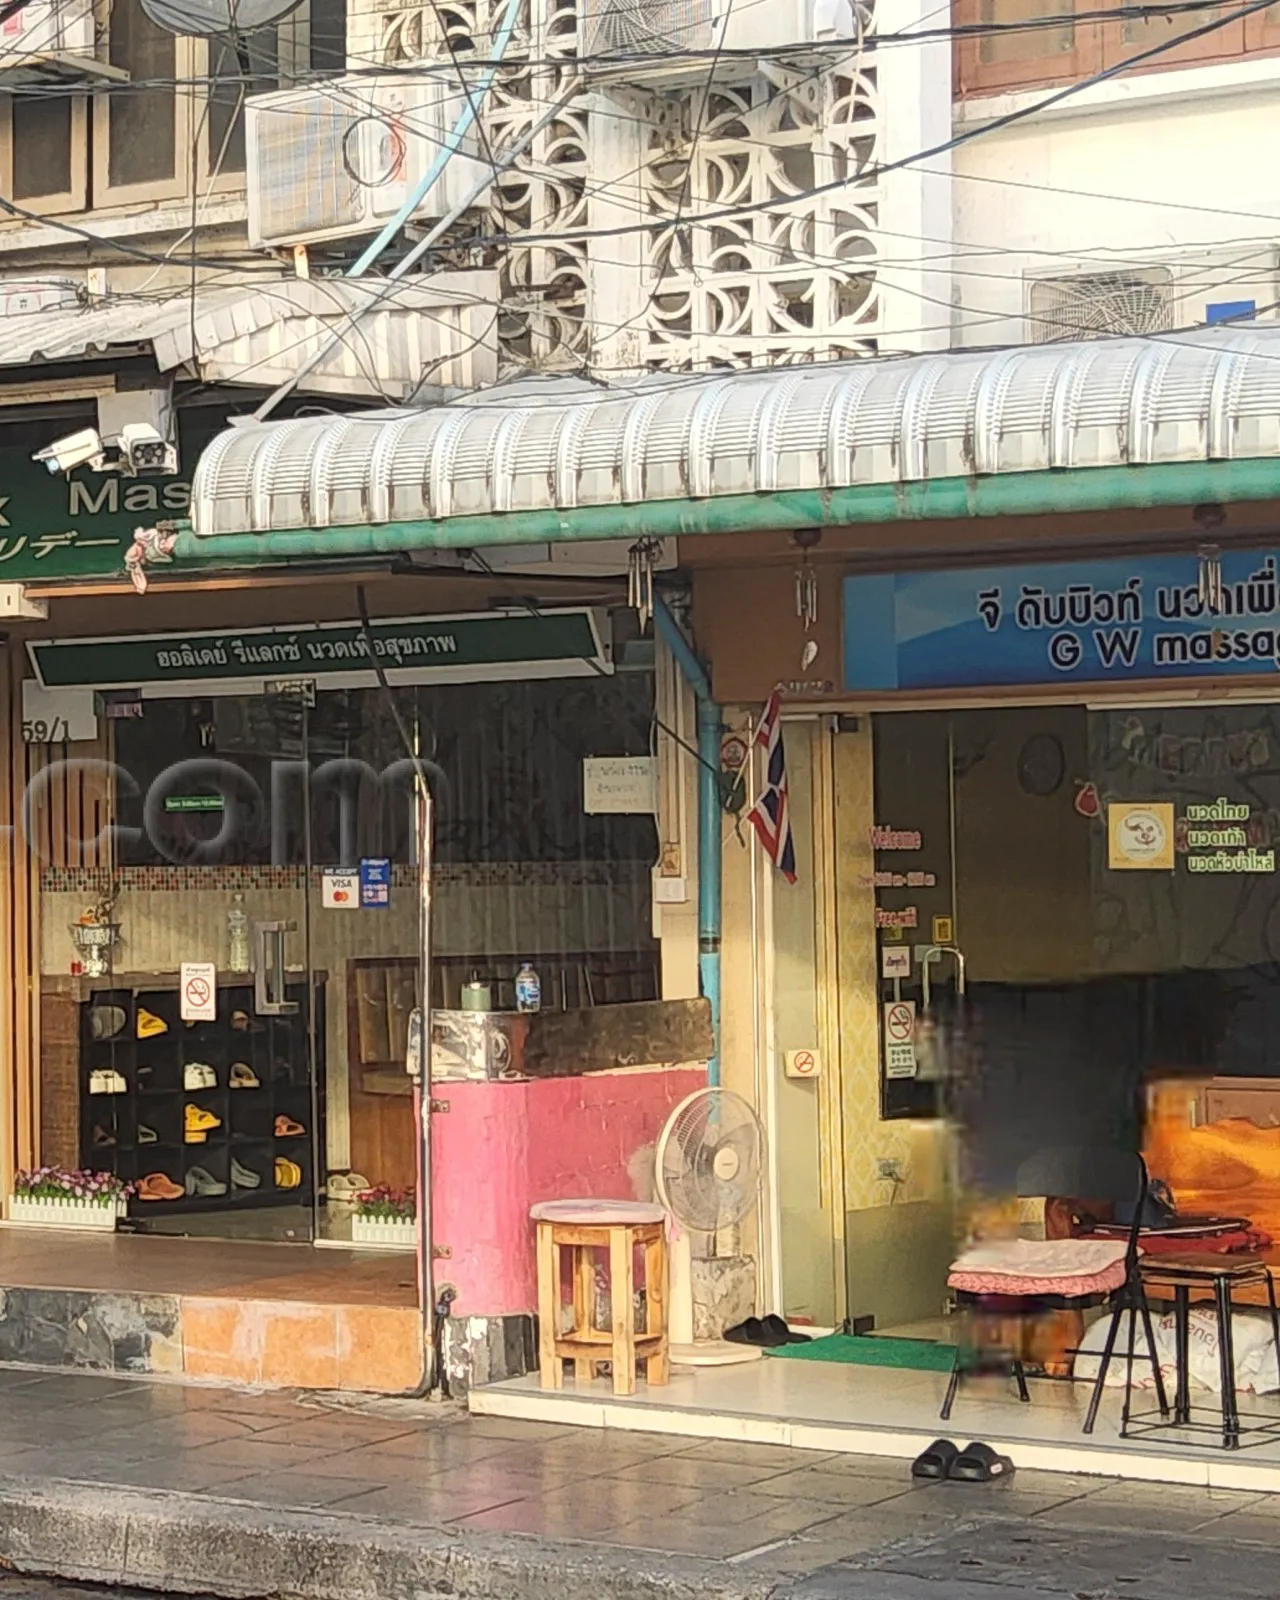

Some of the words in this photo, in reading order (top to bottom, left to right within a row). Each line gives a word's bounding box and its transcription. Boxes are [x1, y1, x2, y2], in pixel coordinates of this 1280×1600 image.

[978, 587, 1000, 630] จี
[1017, 577, 1142, 628] ดับบิวท์
[156, 639, 227, 667] ฮอลิเดย์
[231, 635, 301, 665] รีแลกซ์
[1051, 633, 1080, 667] G
[1095, 628, 1140, 666] W
[1156, 628, 1280, 669] massa
[22, 716, 71, 742] 59/1
[1187, 798, 1249, 821] นวดไทย
[331, 879, 352, 888] VISA
